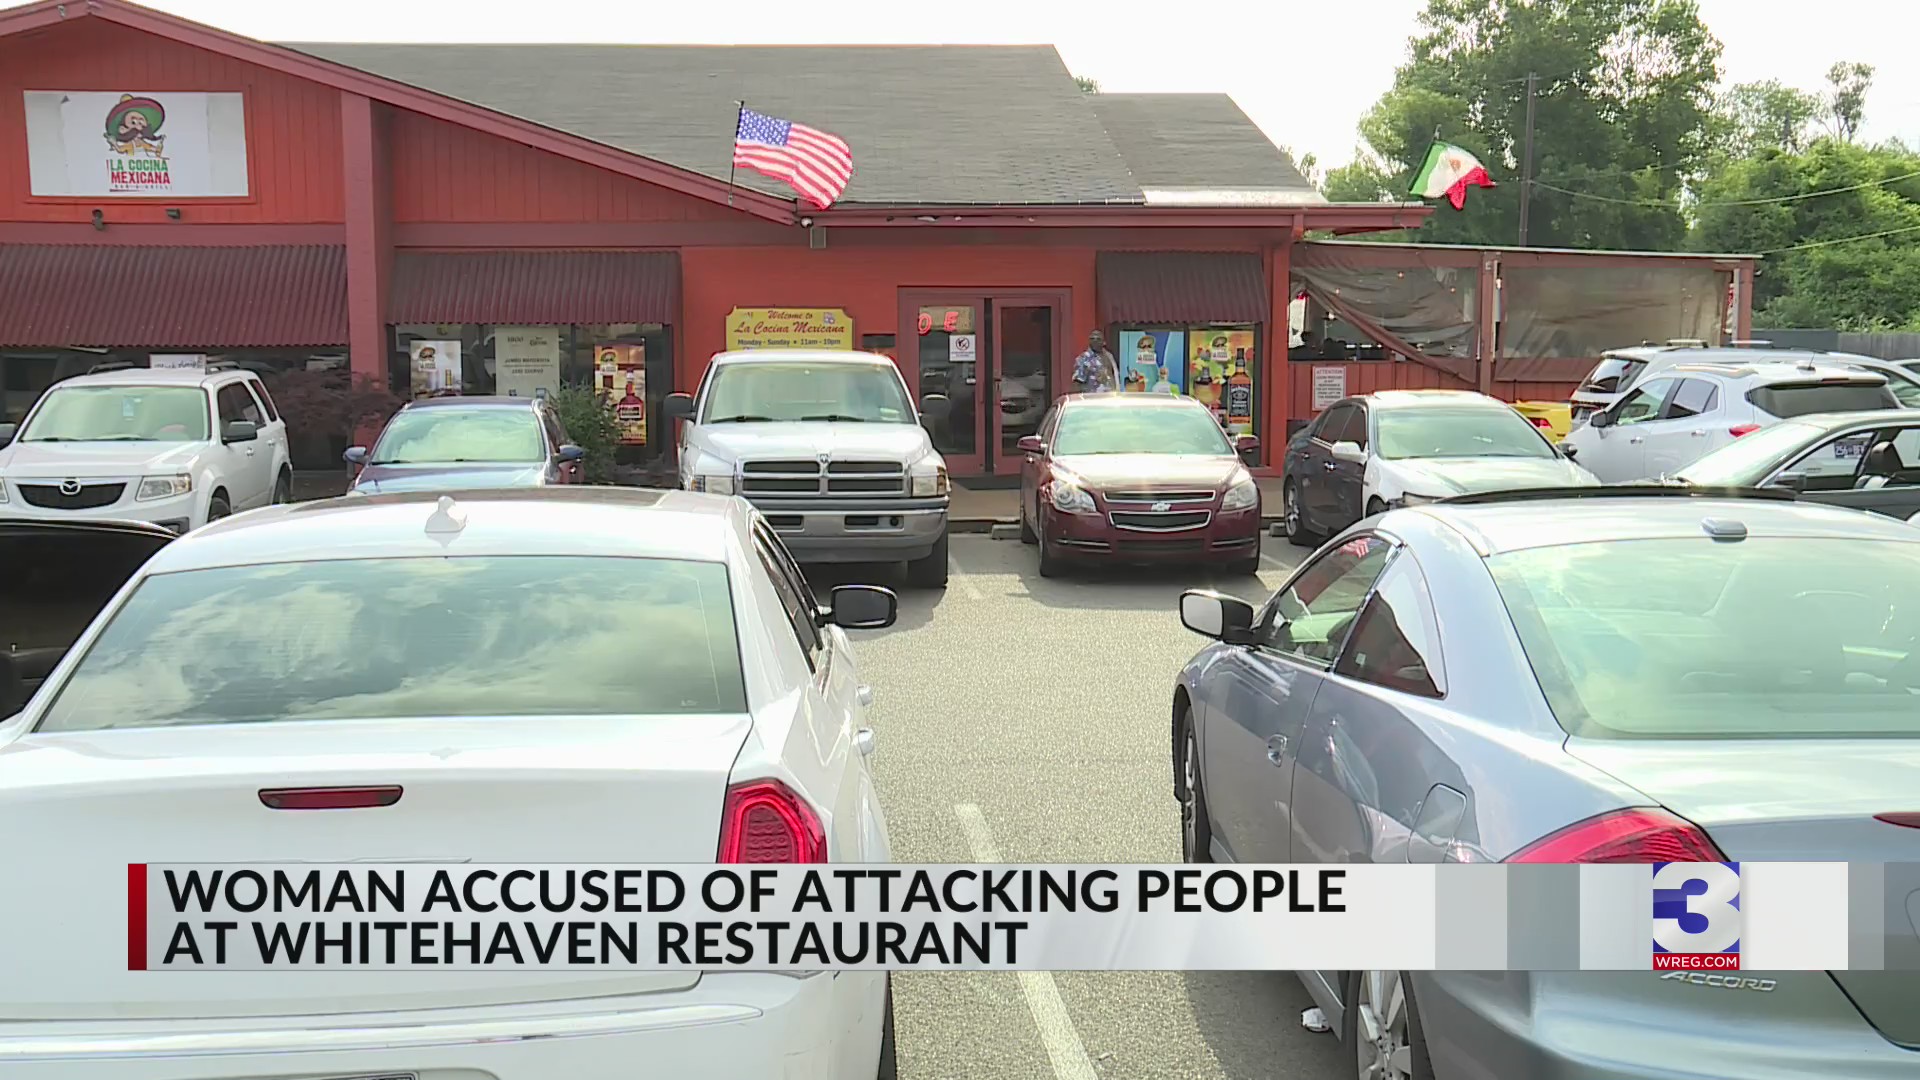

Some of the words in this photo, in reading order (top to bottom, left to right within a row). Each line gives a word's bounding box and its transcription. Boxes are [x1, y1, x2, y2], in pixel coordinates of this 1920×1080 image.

[110, 159, 123, 171] LA
[128, 159, 168, 171] COCINA
[111, 171, 170, 184] MEXICANA
[767, 310, 802, 320] Welcome
[805, 311, 813, 319] to
[734, 321, 751, 333] La
[753, 321, 789, 334] Cocina
[793, 321, 845, 333] Mexicana
[737, 339, 762, 347] Monday
[767, 338, 790, 347] Sunday
[1660, 970, 1777, 992] ACCORD
